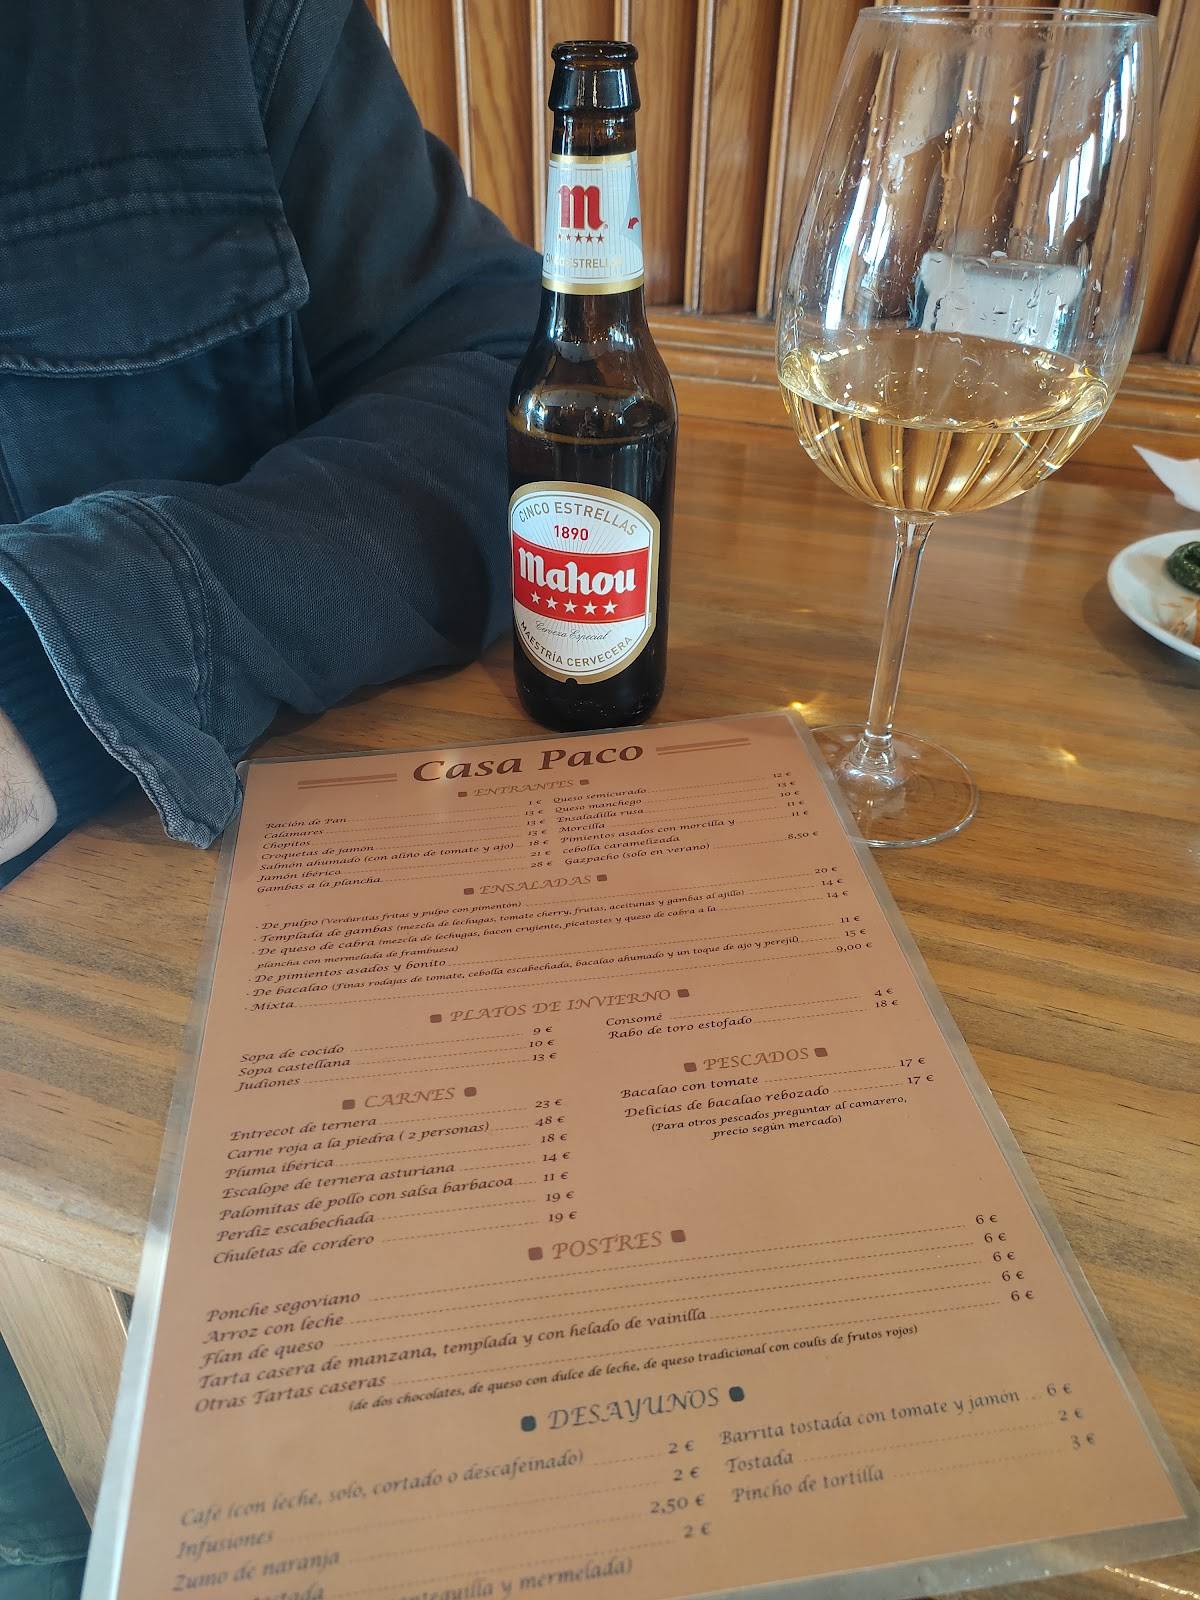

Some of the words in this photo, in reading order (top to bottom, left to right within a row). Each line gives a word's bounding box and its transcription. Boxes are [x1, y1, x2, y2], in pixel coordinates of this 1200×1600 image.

[519, 502, 550, 523] CINCO
[555, 502, 638, 536] ESTRELLAS
[554, 525, 589, 541] 1890
[535, 621, 567, 638] Cerveza
[569, 628, 613, 643] Especial
[521, 621, 563, 665] MAESTRÍA
[567, 636, 633, 667] CERVECERA
[413, 756, 523, 782] Casa
[538, 744, 645, 771] Paco
[473, 779, 574, 797] ENTRANTES
[553, 796, 583, 804] Queso
[586, 787, 647, 799] semicurado
[555, 805, 585, 814] Queso
[589, 799, 642, 809] manchego
[556, 810, 617, 823] Ensaladilla
[264, 830, 323, 840] Calamares
[560, 822, 605, 832] Morcilla
[560, 833, 614, 843] Pimientos
[618, 827, 654, 838] asados
[680, 820, 725, 830] morcilla
[263, 841, 310, 850] Chopitos
[563, 844, 600, 854] cebolla
[604, 835, 680, 850] caramelizada
[565, 853, 619, 865] Gazpacho
[622, 849, 647, 859] (solo
[666, 842, 710, 853] verano)
[259, 861, 302, 871] Salmón
[306, 855, 361, 867] ahumado
[261, 850, 319, 860] Croquetas
[257, 873, 298, 882] Jamón
[480, 875, 591, 895] ENSALADAS
[257, 883, 304, 893] Gambas
[260, 930, 323, 943] Templada
[344, 924, 392, 938] gambas
[279, 918, 318, 931] pulpo
[280, 945, 316, 956] queso
[338, 939, 374, 949] cabra
[275, 969, 343, 983] pimientos
[346, 963, 389, 975] asados
[406, 960, 446, 970] bonito
[276, 983, 328, 995] bacalao
[250, 1002, 294, 1012] Mixta
[450, 1004, 527, 1022] PLATOS
[532, 1001, 561, 1014] DE
[566, 989, 671, 1011] INVIERNO
[606, 1014, 662, 1026] Consomé
[608, 1027, 643, 1039] Rabo
[667, 1024, 694, 1033] toro
[698, 1015, 752, 1030] estofado
[529, 1040, 543, 1048] 10
[240, 1053, 274, 1065] Sopa
[280, 1048, 295, 1059] de
[300, 1046, 344, 1057] cocido
[533, 1053, 545, 1062] 13
[703, 1047, 809, 1071] PESCADOS
[900, 1058, 913, 1067] 17
[238, 1067, 272, 1078] Sopa
[278, 1058, 350, 1072] castellana
[234, 1078, 300, 1092] Judiones
[620, 1084, 677, 1099] Bacalao
[682, 1082, 705, 1092] con
[711, 1077, 759, 1089] tomate
[907, 1076, 921, 1085] 17
[364, 1087, 455, 1108] CARNES
[535, 1100, 550, 1109] 23
[624, 1104, 682, 1118] Delicias
[687, 1099, 702, 1111] de
[707, 1094, 762, 1108] bacalao
[765, 1085, 829, 1102] rebozado
[535, 1116, 552, 1127] 48
[651, 1122, 684, 1132] (Para
[688, 1118, 717, 1127] otros
[718, 1110, 770, 1127] pescados
[772, 1105, 831, 1121] preguntar
[849, 1096, 907, 1109] camarero,
[230, 1126, 294, 1141] Entrecot
[321, 1118, 376, 1131] ternera
[711, 1128, 749, 1141] precio
[752, 1123, 785, 1135] según
[788, 1114, 842, 1129] mercado)
[227, 1148, 273, 1160] Carne
[278, 1144, 308, 1156] roja
[342, 1132, 394, 1150] piedra
[418, 1121, 489, 1142] personas)
[222, 1182, 289, 1199] Escalope
[317, 1173, 375, 1188] ternera
[380, 1164, 454, 1180] asturiana
[225, 1166, 276, 1179] Pluma
[219, 1203, 300, 1221] Palomitas
[324, 1192, 364, 1212] pollo
[368, 1192, 395, 1202] con
[399, 1184, 437, 1199] salsa
[442, 1178, 513, 1194] barbacoa
[216, 1225, 271, 1242] Perdiz
[275, 1211, 375, 1235] escabechada
[549, 1213, 564, 1223] 19
[975, 1214, 984, 1225] 6
[213, 1246, 284, 1264] Chuletas
[312, 1234, 374, 1252] cordero
[552, 1230, 662, 1260] POSTRES
[207, 1302, 269, 1323] Ponche
[273, 1293, 360, 1315] segoviano
[202, 1328, 258, 1344] Arroz
[264, 1323, 295, 1336] con
[300, 1313, 344, 1331] leche
[199, 1372, 250, 1389] Tarta
[256, 1363, 315, 1381] casera
[348, 1347, 437, 1368] manzana,
[443, 1332, 517, 1356] templada
[537, 1330, 565, 1342] con
[570, 1318, 620, 1337] helado
[646, 1307, 706, 1326] vainilla
[199, 1349, 242, 1370] Flan
[274, 1340, 324, 1360] queso
[396, 1387, 464, 1404] chocolates,
[698, 1342, 767, 1362] tradicional
[847, 1331, 882, 1346] frutos
[885, 1324, 918, 1339] rojos)
[195, 1396, 246, 1412] Otras
[253, 1386, 313, 1405] Tartas
[319, 1376, 386, 1395] caseras
[1046, 1384, 1057, 1396] 6
[547, 1387, 719, 1430] DESAYUNOS
[722, 1425, 785, 1445] Barrita
[790, 1415, 852, 1435] tostada
[857, 1411, 886, 1424] con
[891, 1401, 947, 1420] tomate
[668, 1442, 678, 1454] 2
[1070, 1435, 1081, 1450] 3
[726, 1448, 793, 1473] Tostada
[372, 1468, 443, 1495] cortado
[463, 1449, 584, 1481] descafeinado)
[732, 1483, 793, 1503] Pincho
[823, 1464, 884, 1489] tortilla
[650, 1497, 689, 1514] 2,50
[176, 1532, 272, 1560] Infusiones
[262, 1552, 340, 1576] naranja
